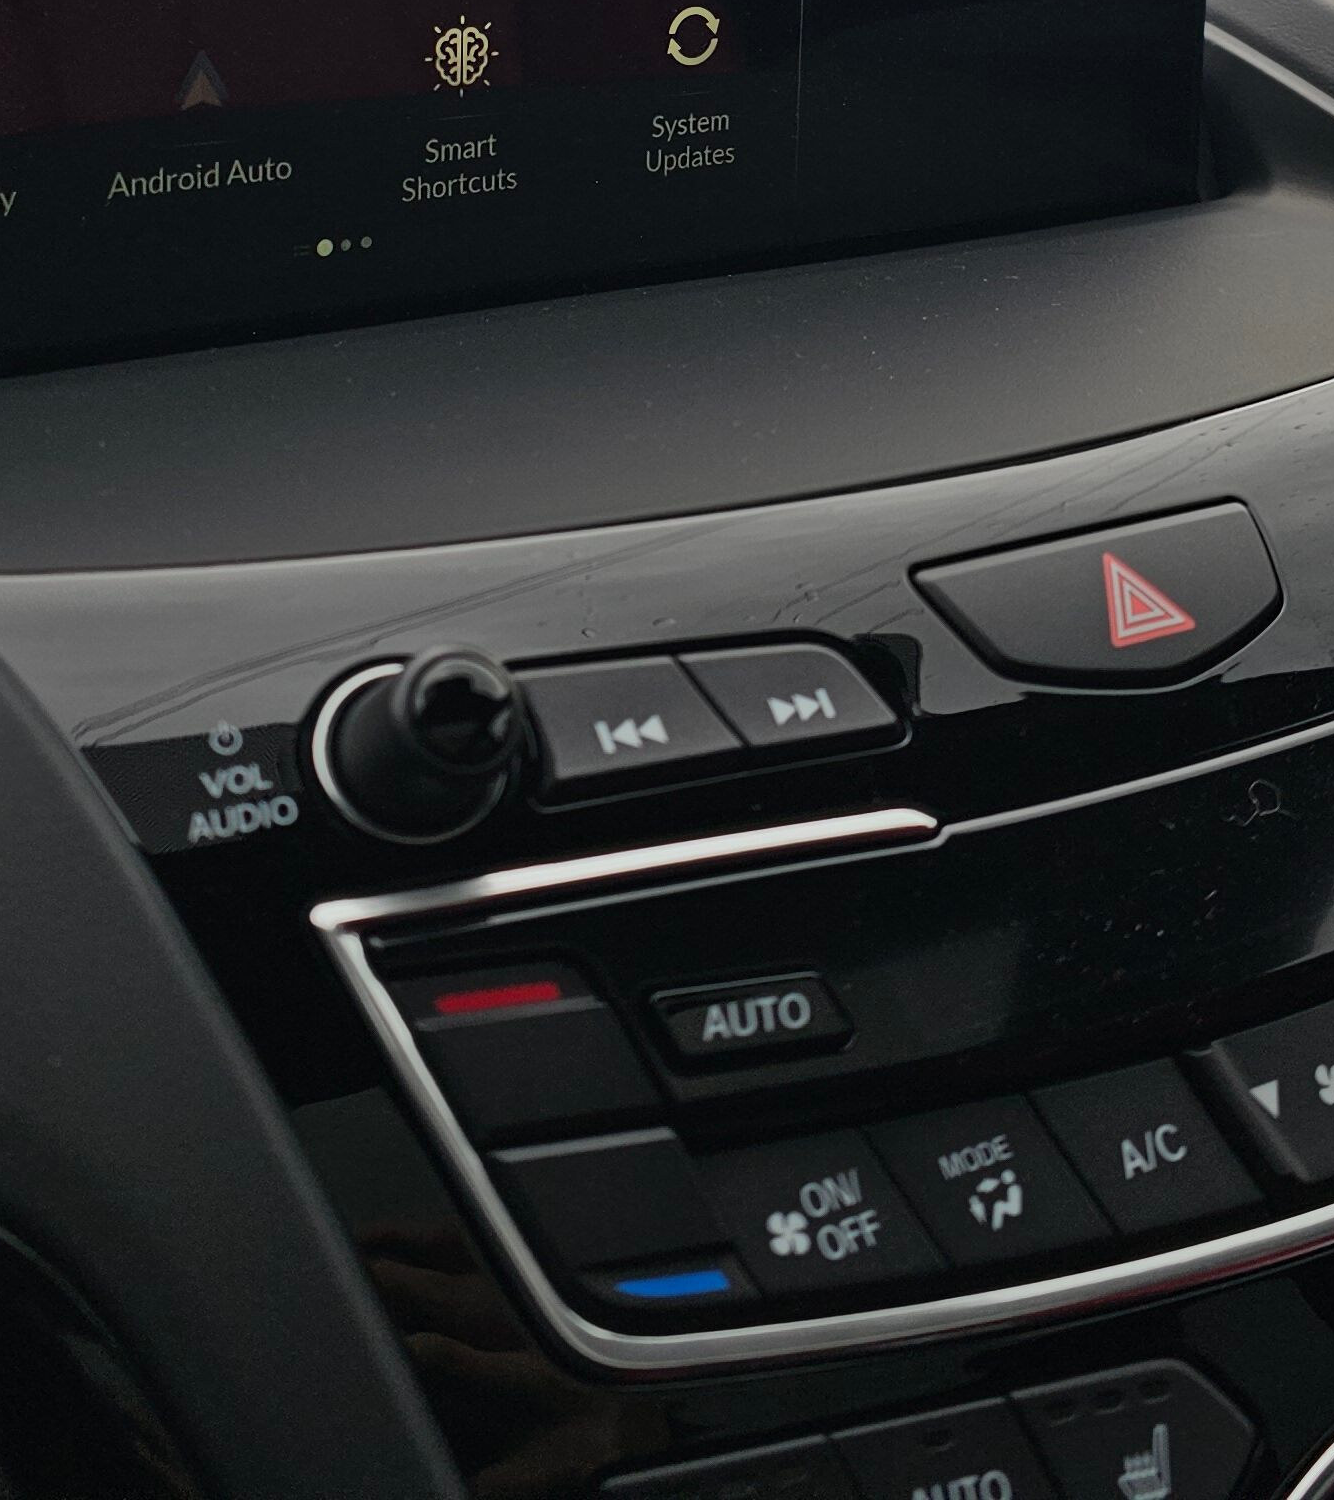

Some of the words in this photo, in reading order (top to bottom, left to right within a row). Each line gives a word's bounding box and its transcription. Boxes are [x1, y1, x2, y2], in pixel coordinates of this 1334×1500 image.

[651, 111, 730, 140] System
[425, 134, 497, 163] Smart
[645, 143, 735, 177] Updates
[108, 162, 220, 199] Android
[227, 156, 292, 185] Auto
[402, 167, 517, 201] Shortcuts
[199, 763, 272, 798] VOL
[187, 796, 298, 844] AUDIO
[702, 992, 811, 1042] AUTO
[937, 1134, 1015, 1181] MODE
[1120, 1123, 1187, 1180] A/C
[799, 1167, 863, 1218] ON/
[816, 1209, 881, 1261] OFF
